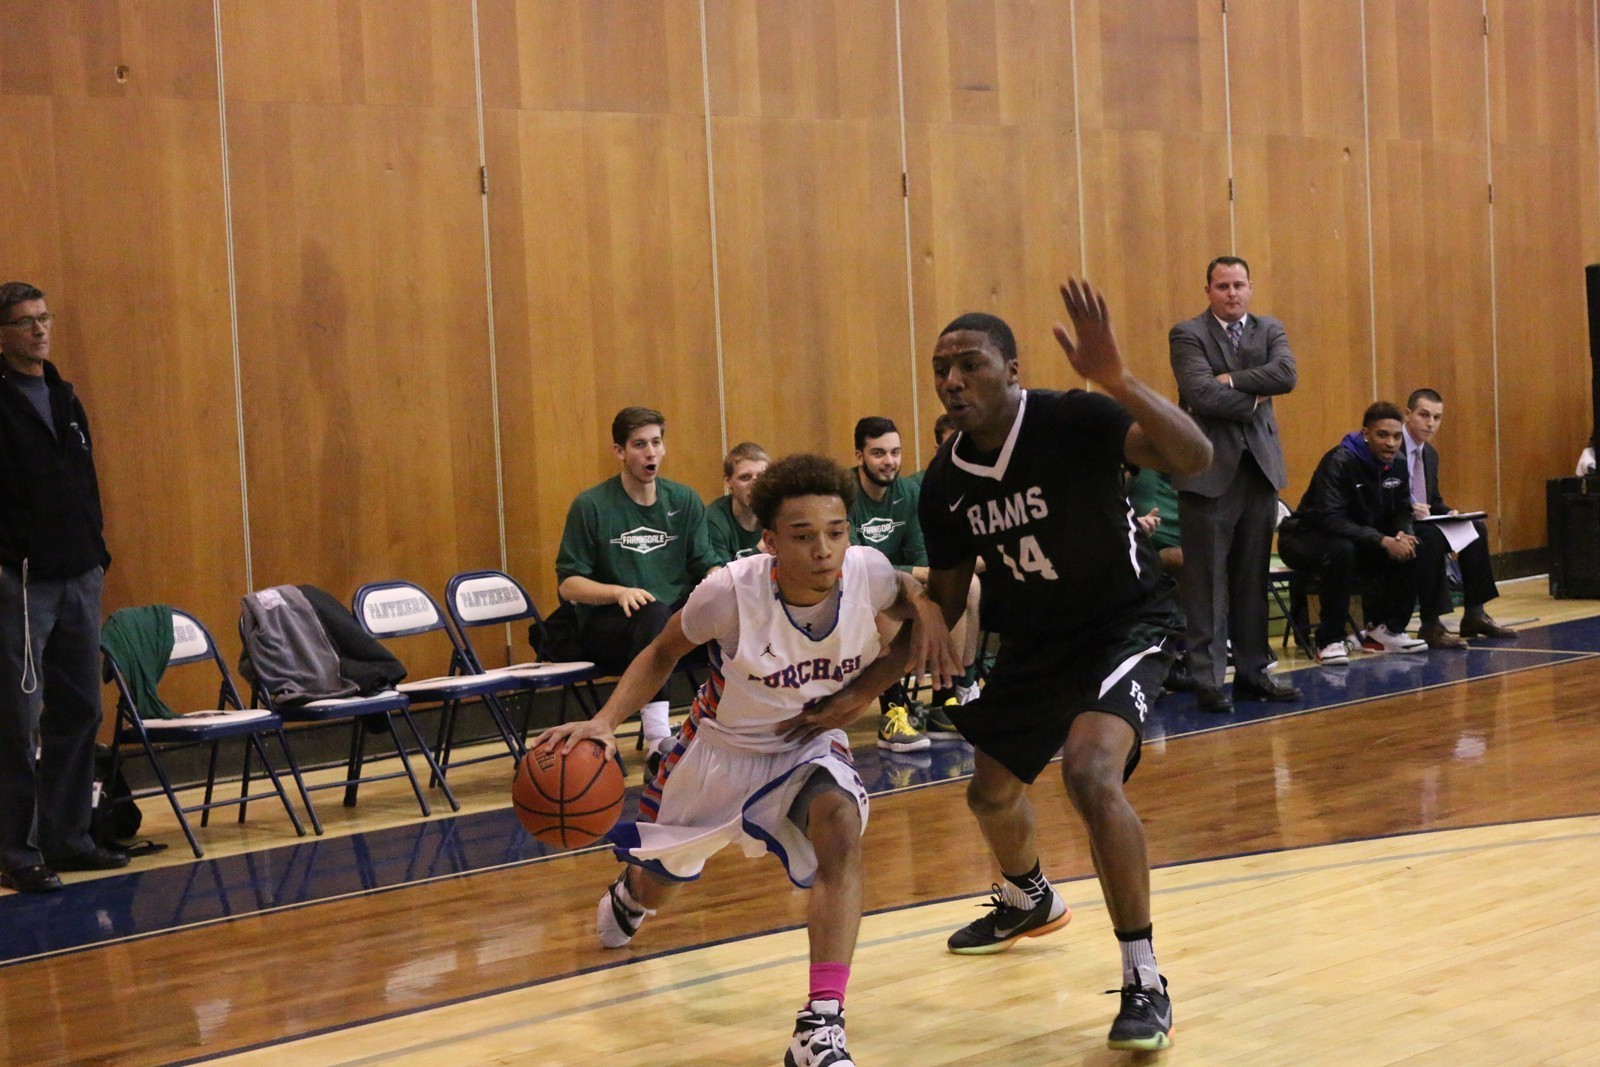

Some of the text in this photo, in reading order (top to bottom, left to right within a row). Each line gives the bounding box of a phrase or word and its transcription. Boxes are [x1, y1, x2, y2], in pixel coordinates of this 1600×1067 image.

[967, 485, 1049, 536] RAMS
[996, 534, 1059, 583] 14
[366, 596, 430, 620] PANTHERS
[459, 585, 521, 608] PANTHERS
[1129, 679, 1148, 723] FSC
